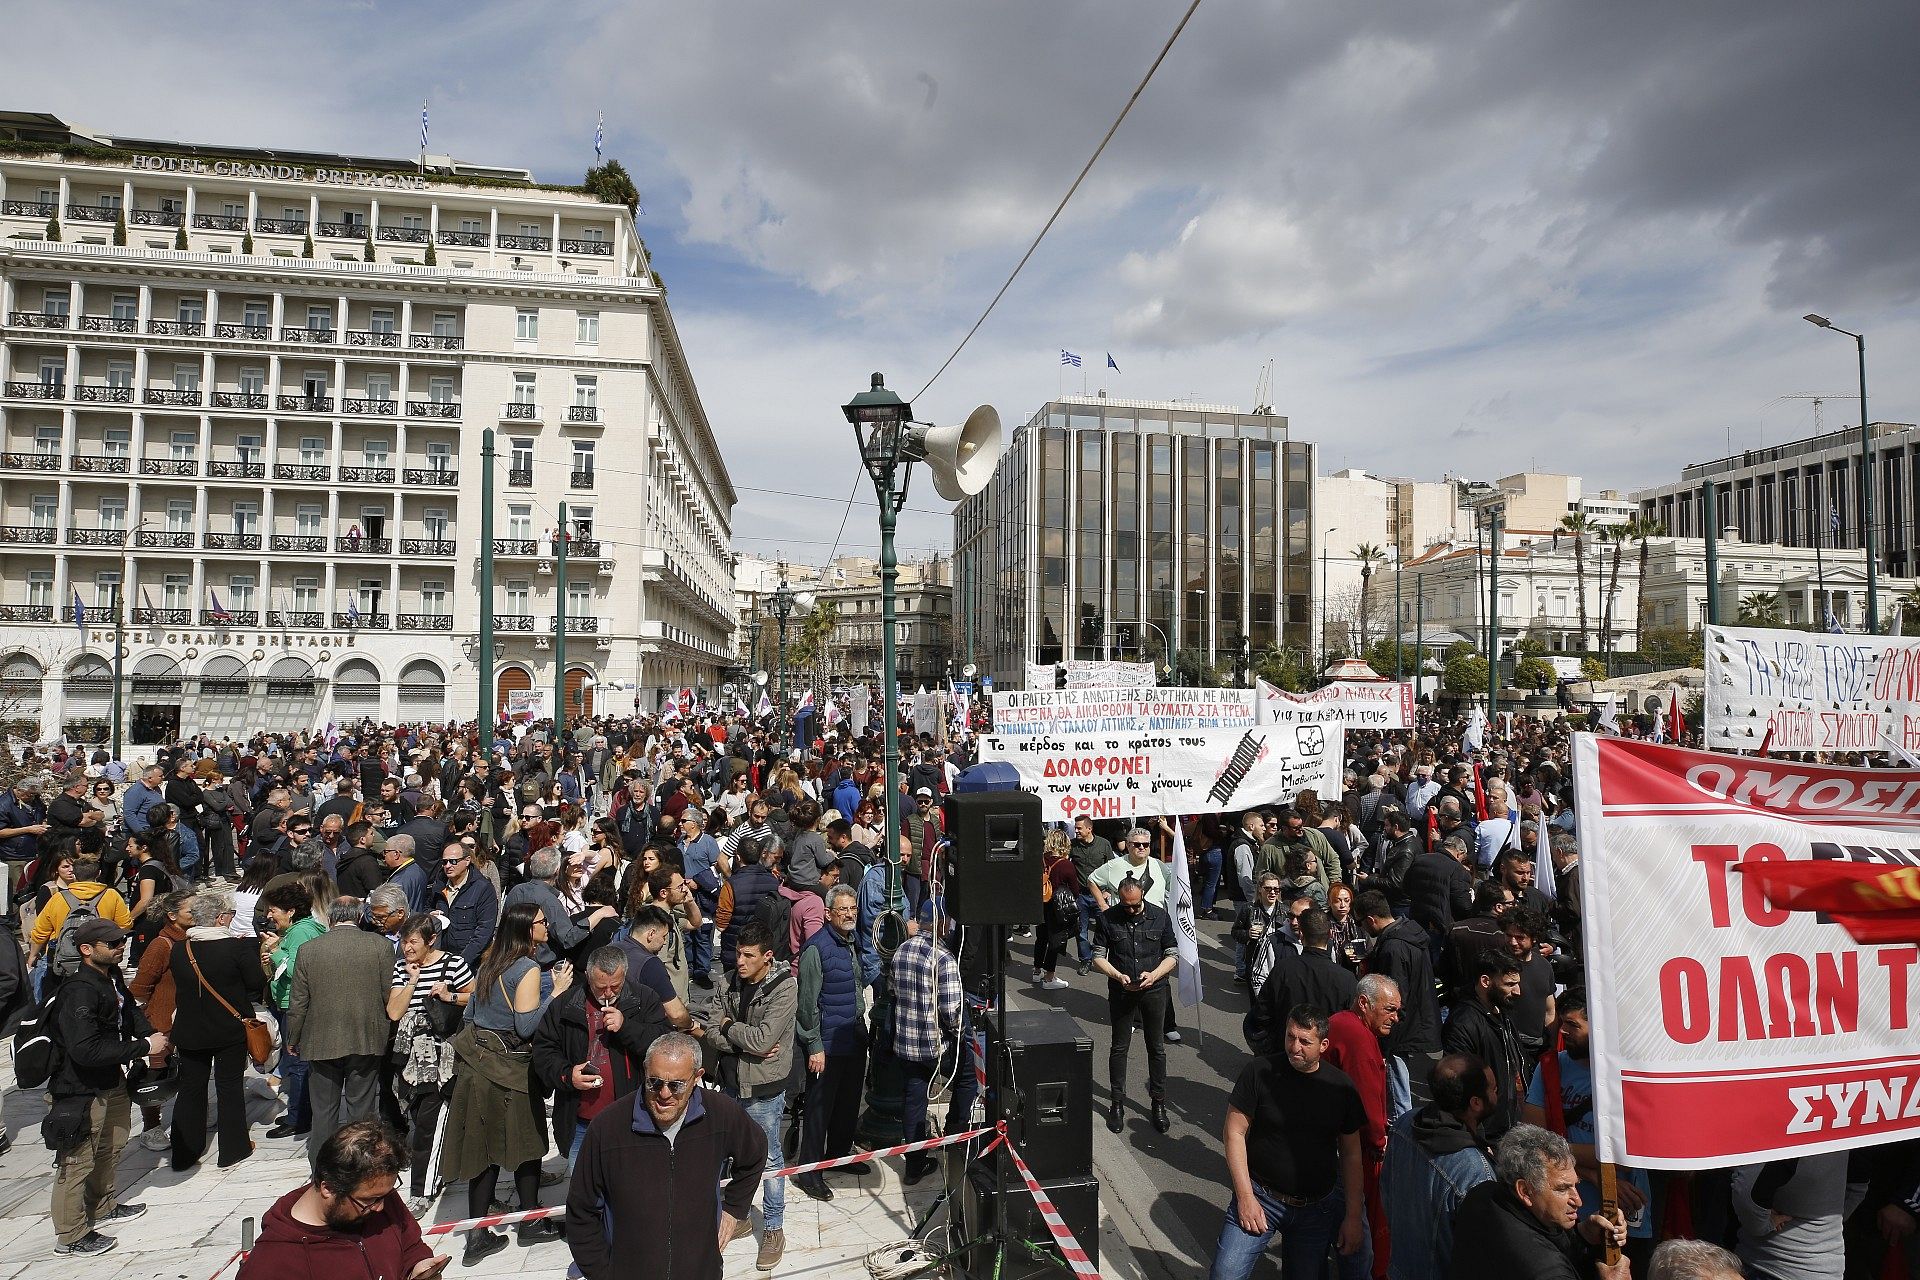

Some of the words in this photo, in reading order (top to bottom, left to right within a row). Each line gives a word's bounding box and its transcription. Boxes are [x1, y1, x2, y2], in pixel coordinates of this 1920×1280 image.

[131, 154, 205, 174] HOTEL
[214, 161, 305, 181] GRANDE
[315, 168, 426, 190] BRETAGNE
[167, 633, 245, 646] GRANDE
[257, 634, 355, 648] BRETAGNE
[1735, 640, 1772, 696] ΤΑ
[1816, 645, 1873, 702] ΤΟΥΣ
[1874, 648, 1899, 701] ΟΙ
[1008, 693, 1019, 707] ΟΙ
[1022, 692, 1053, 706] ΡΑΓΕΣ
[1055, 690, 1079, 704] ΤΗΣ
[1082, 689, 1140, 703] ΑΝΑΠΤΥΞΗΣ
[1203, 690, 1217, 703] ΜΕ
[1219, 690, 1242, 703] ΑΙΜΑ
[996, 709, 1012, 722] ΜΕ
[1017, 707, 1054, 722] ΑΓΩΝΑ
[1058, 705, 1073, 719] ΘΑ
[1138, 703, 1151, 716] ΤΑ
[1153, 703, 1196, 716] ΘΥΜΑΤΑ
[1197, 703, 1220, 716] ΣΤΑ
[1222, 704, 1251, 717] ΤΡΕΝΑ
[987, 738, 1005, 750] Το
[1019, 735, 1065, 755] κέρδος
[1075, 740, 1095, 750] και
[1105, 740, 1119, 750] το
[1128, 734, 1172, 754] κράτος
[1178, 737, 1206, 747] τους
[1043, 755, 1150, 778] ΔΟΛΟΦΟΝΕΙ
[1047, 784, 1071, 793] των
[1078, 778, 1120, 796] νεκρών
[1126, 777, 1140, 790] θα
[1151, 774, 1193, 794] γίνουμε
[1060, 795, 1121, 819] ΦΩΝΗ
[1659, 951, 1860, 1044] ΟΛΩΝ
[1877, 948, 1920, 1030] Τ
